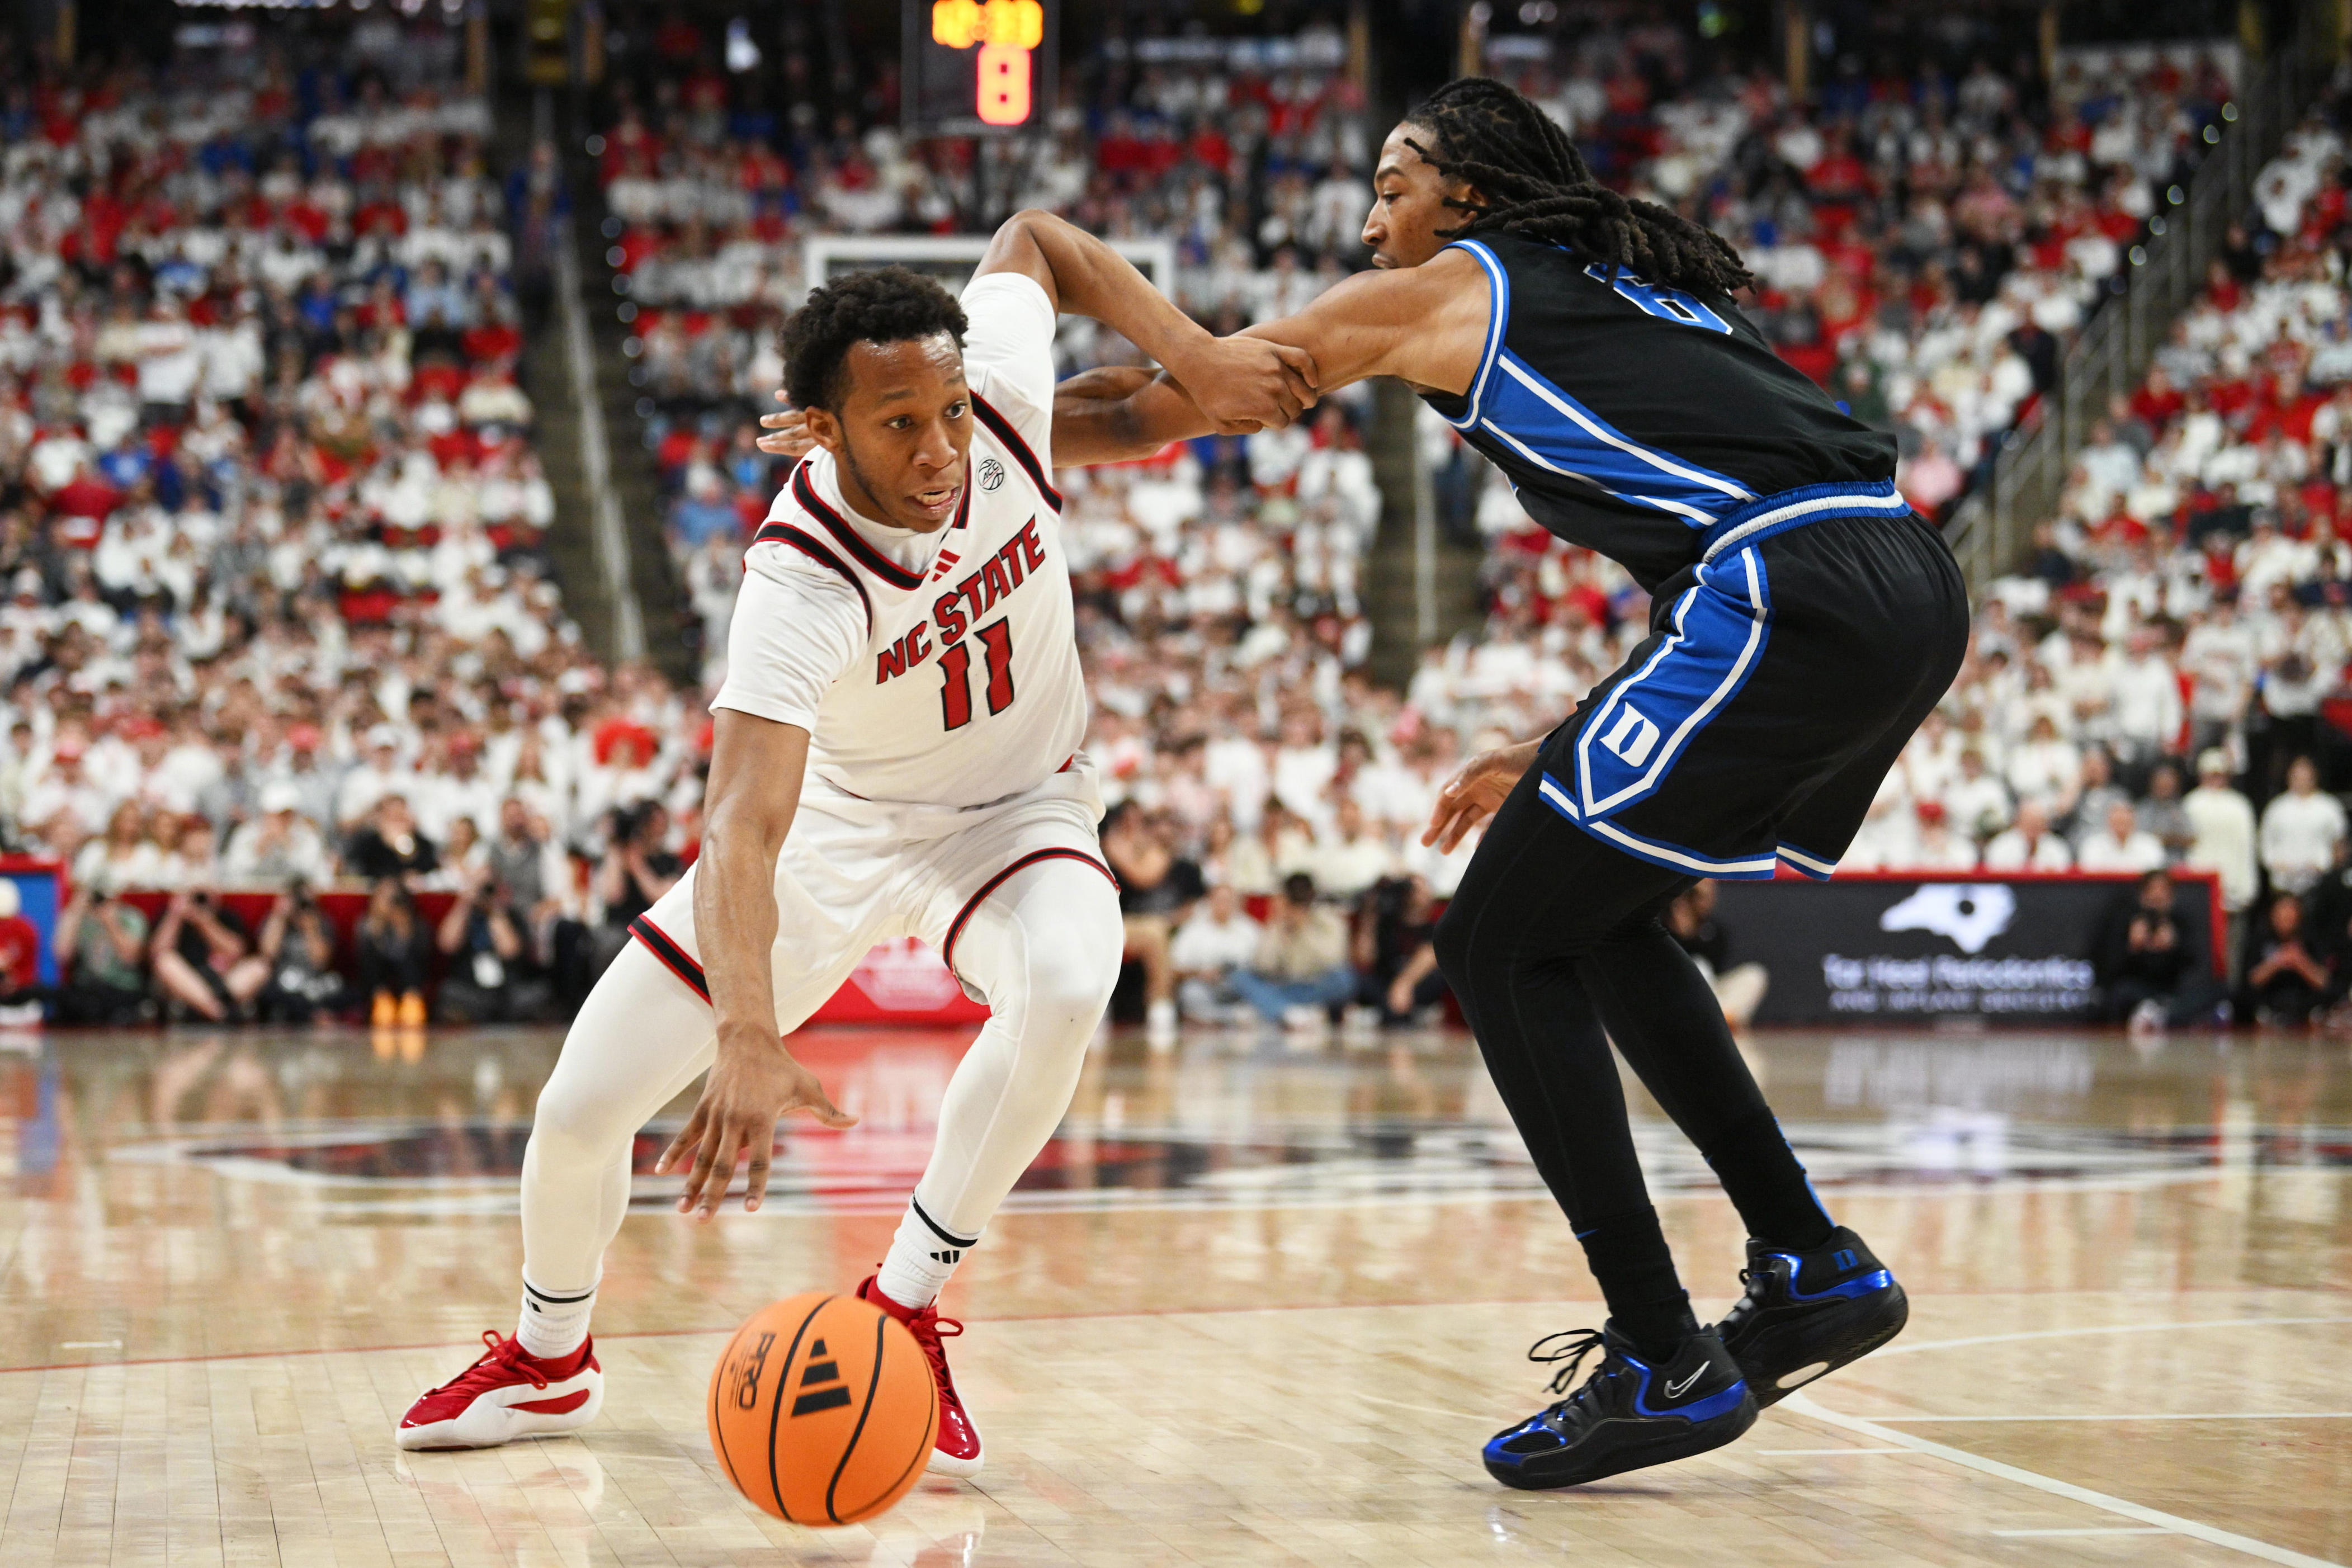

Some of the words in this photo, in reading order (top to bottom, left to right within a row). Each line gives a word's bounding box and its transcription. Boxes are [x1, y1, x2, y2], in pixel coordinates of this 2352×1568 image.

[977, 45, 1031, 125] 8
[982, 461, 999, 483] ACC
[876, 621, 932, 684] NC
[933, 513, 1046, 645] STATE
[936, 616, 1015, 731] 11
[1599, 701, 1660, 767] D
[739, 1332, 776, 1409] PRO
